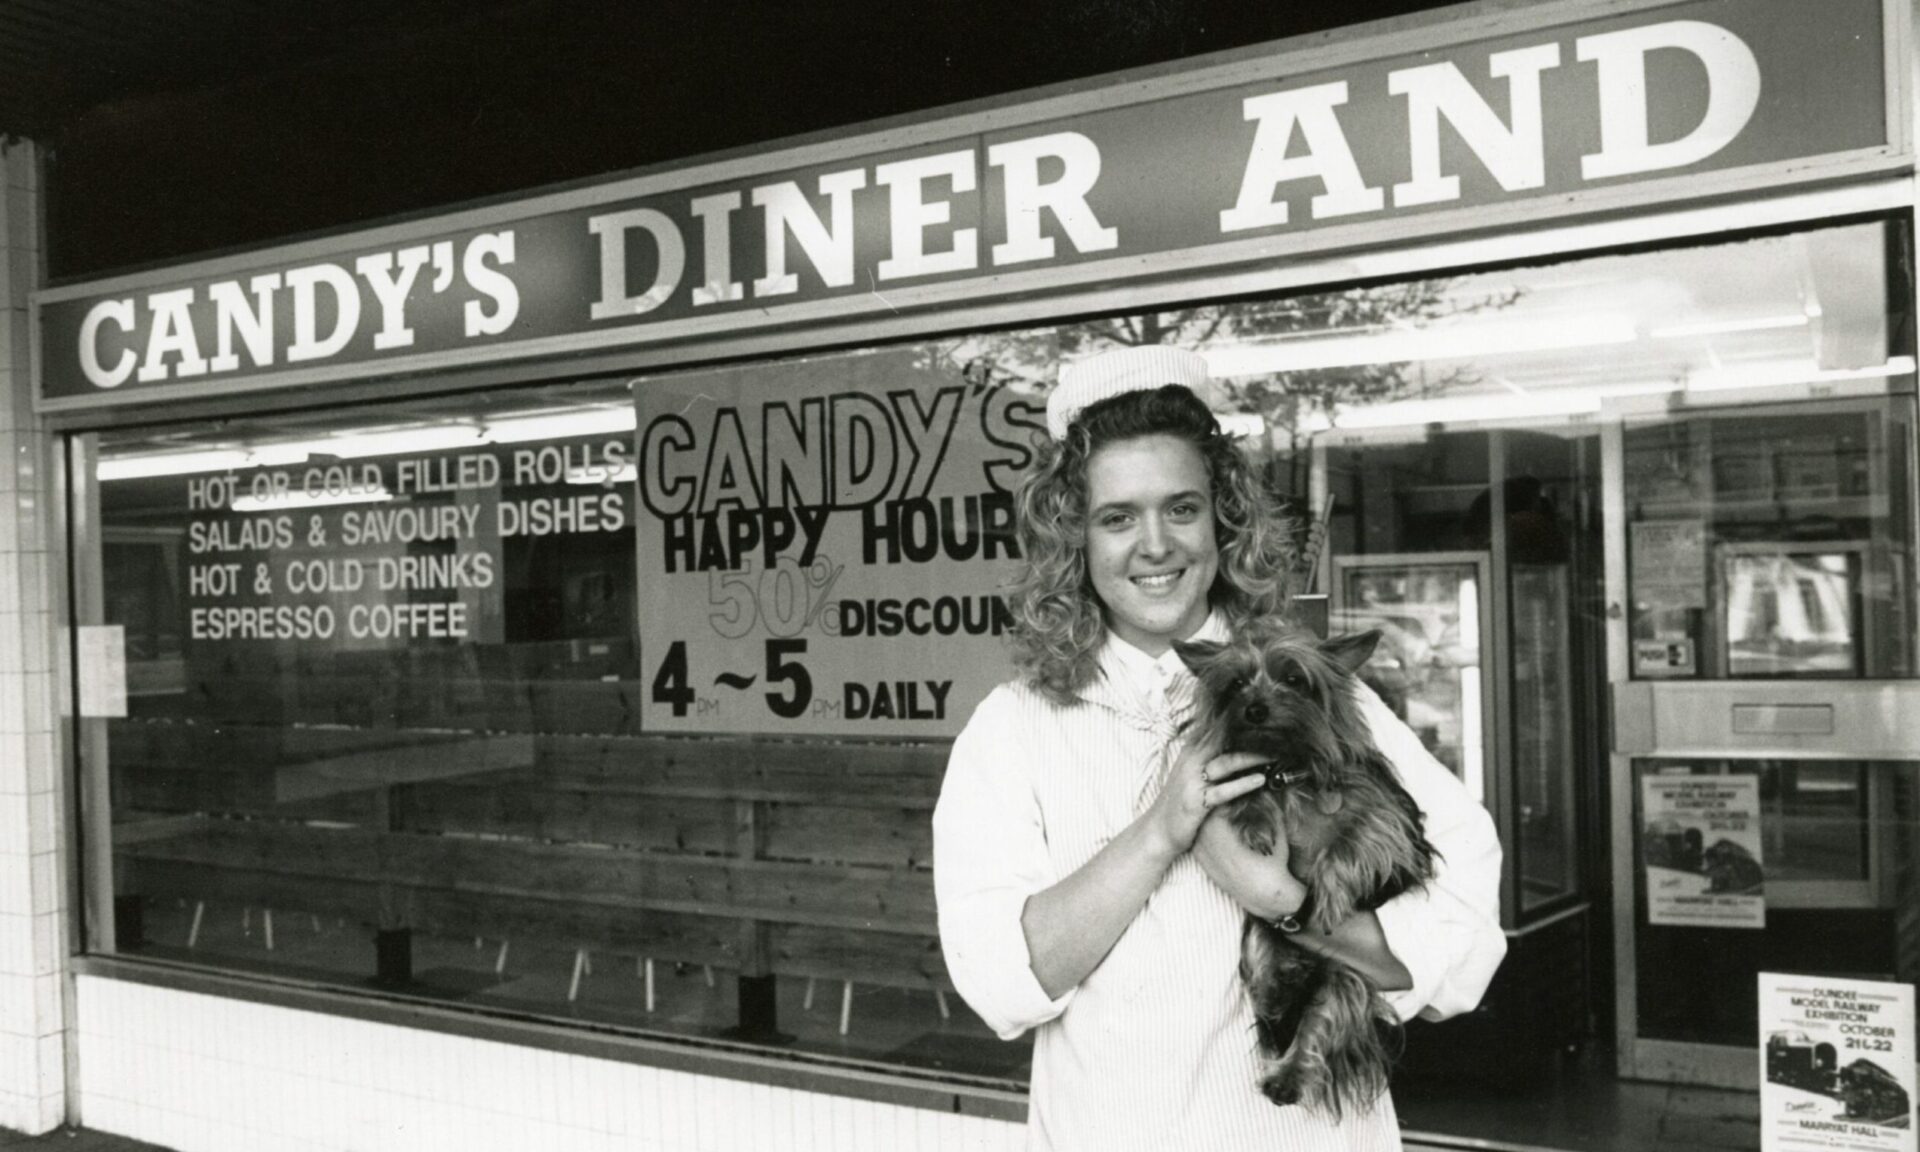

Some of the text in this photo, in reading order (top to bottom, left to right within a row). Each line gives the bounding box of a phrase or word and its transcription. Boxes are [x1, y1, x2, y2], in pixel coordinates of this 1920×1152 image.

[79, 20, 1761, 388] CANDY'S DINER AND
[188, 441, 626, 509] HOT OR COLD FILLED ROLLS
[189, 493, 625, 553] SALADS & SAVOURY DISHES
[664, 492, 1022, 573] HAPPY HOUR
[190, 552, 494, 596] HOT & COLD DRINKS
[708, 554, 1017, 639] 50% DISCOUN
[191, 603, 467, 639] ESPRESSO COFFEE
[844, 680, 953, 721] DAILY
[1790, 996, 1881, 1014] MODEL RAILWAY
[1812, 988, 1857, 1000] DUNDEE
[1805, 1009, 1867, 1023] EXHIBITION
[1839, 1024, 1895, 1037] OCTOBER
[1799, 1120, 1878, 1137] MARRYAT HALL
